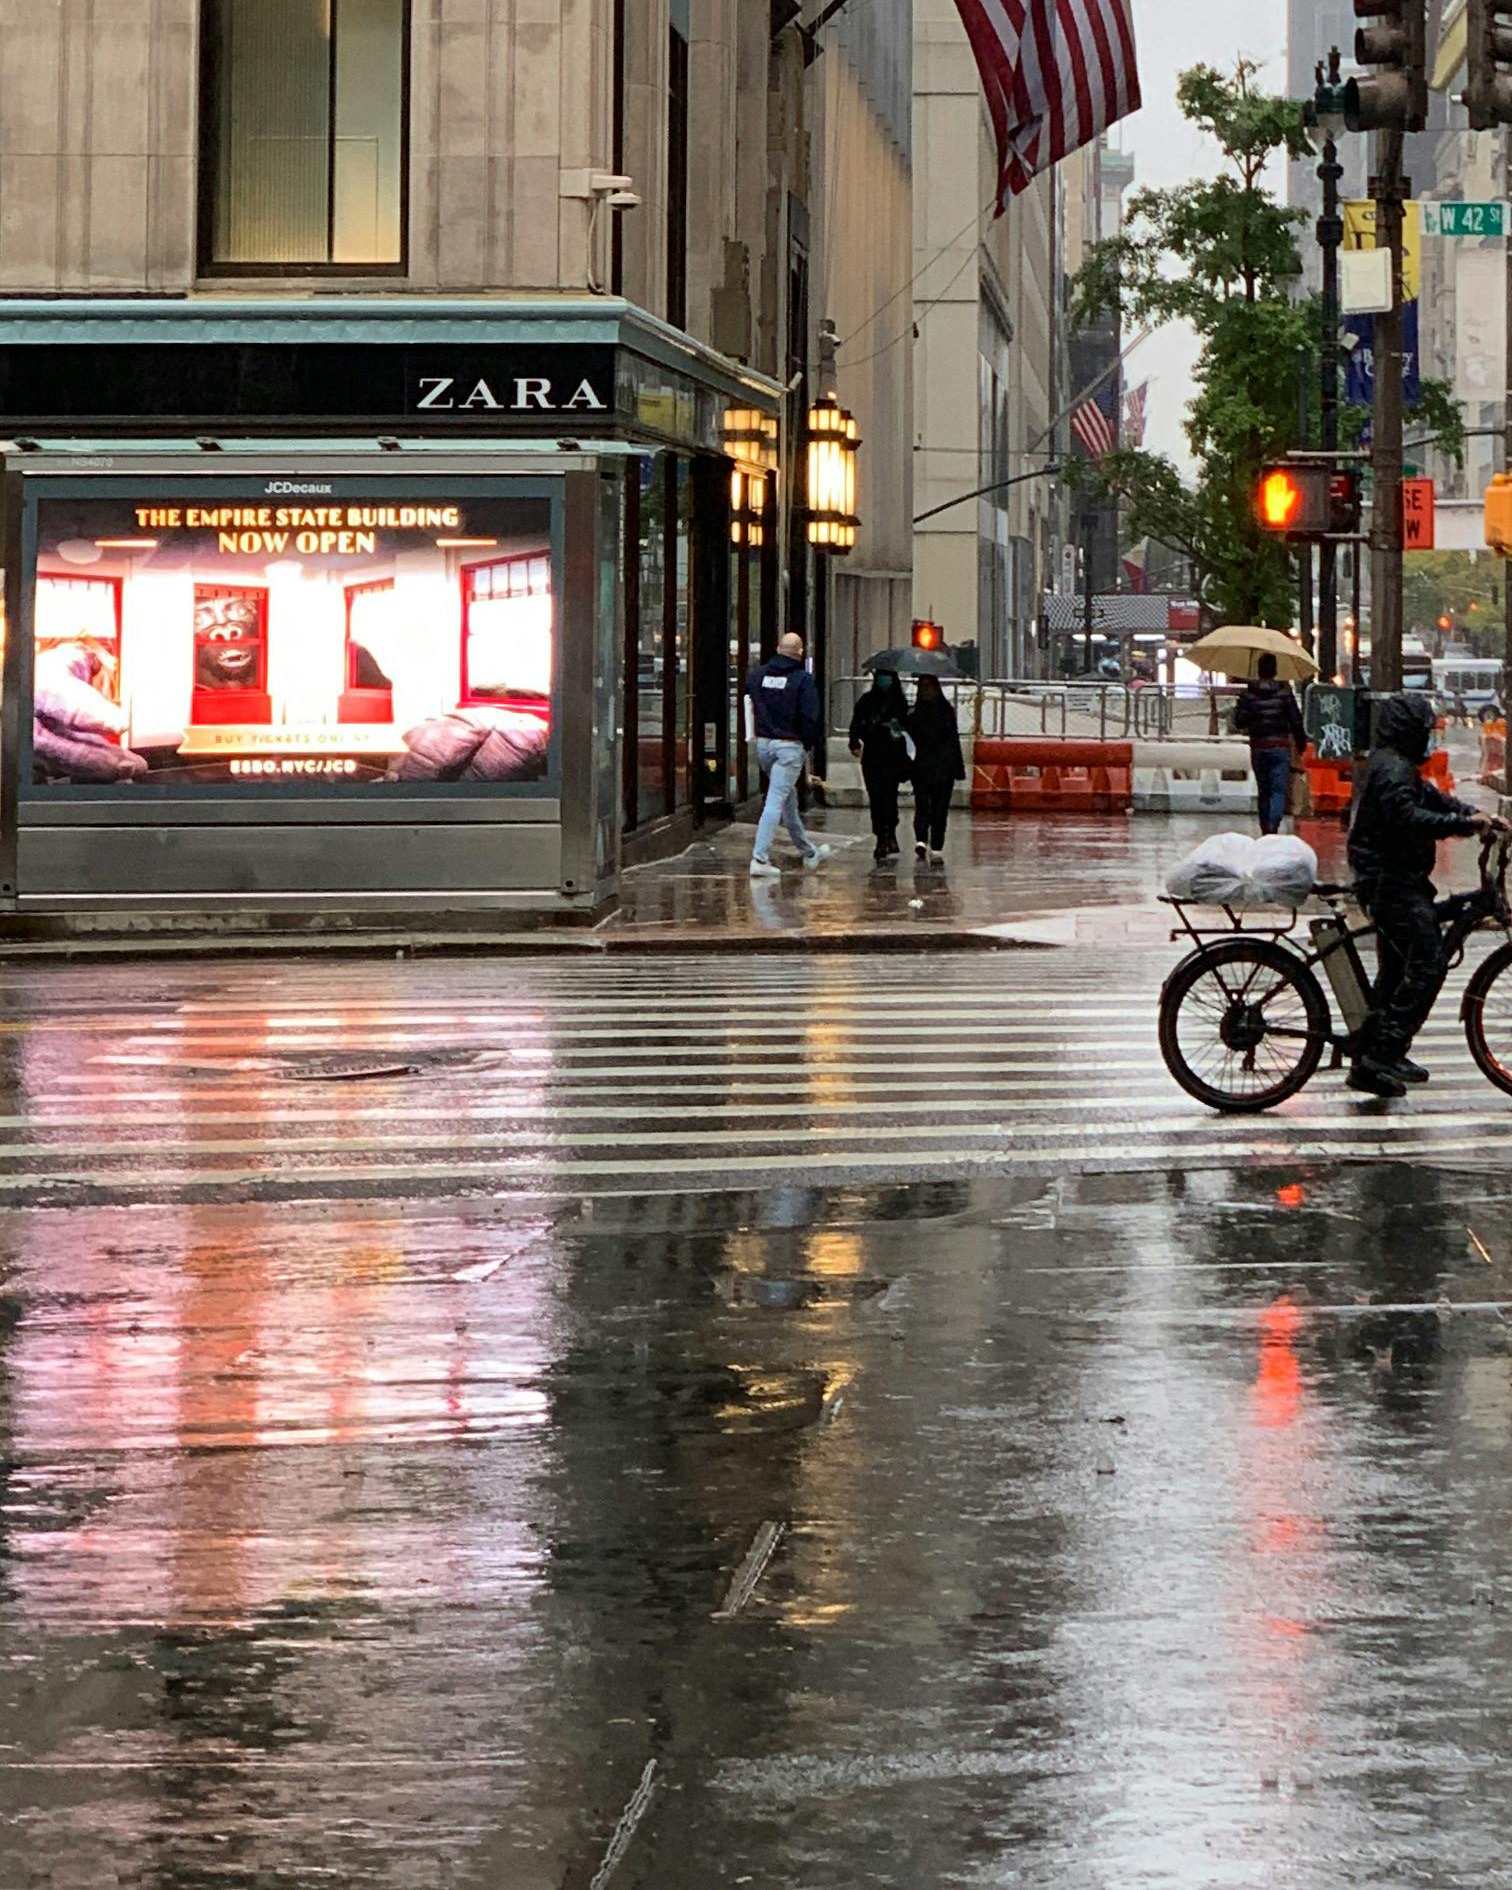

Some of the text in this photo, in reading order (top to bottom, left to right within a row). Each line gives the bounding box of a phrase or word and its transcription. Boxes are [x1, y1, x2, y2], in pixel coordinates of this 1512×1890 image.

[1441, 206, 1456, 231] W
[1462, 205, 1484, 232] 42
[416, 378, 607, 409] ZARA
[264, 481, 332, 494] JCDecaux
[135, 508, 459, 527] THE EMPIRE STATE BUILDING
[218, 531, 375, 554] NOW OPEN
[215, 734, 244, 745] BUY
[251, 734, 311, 745] TICKETS
